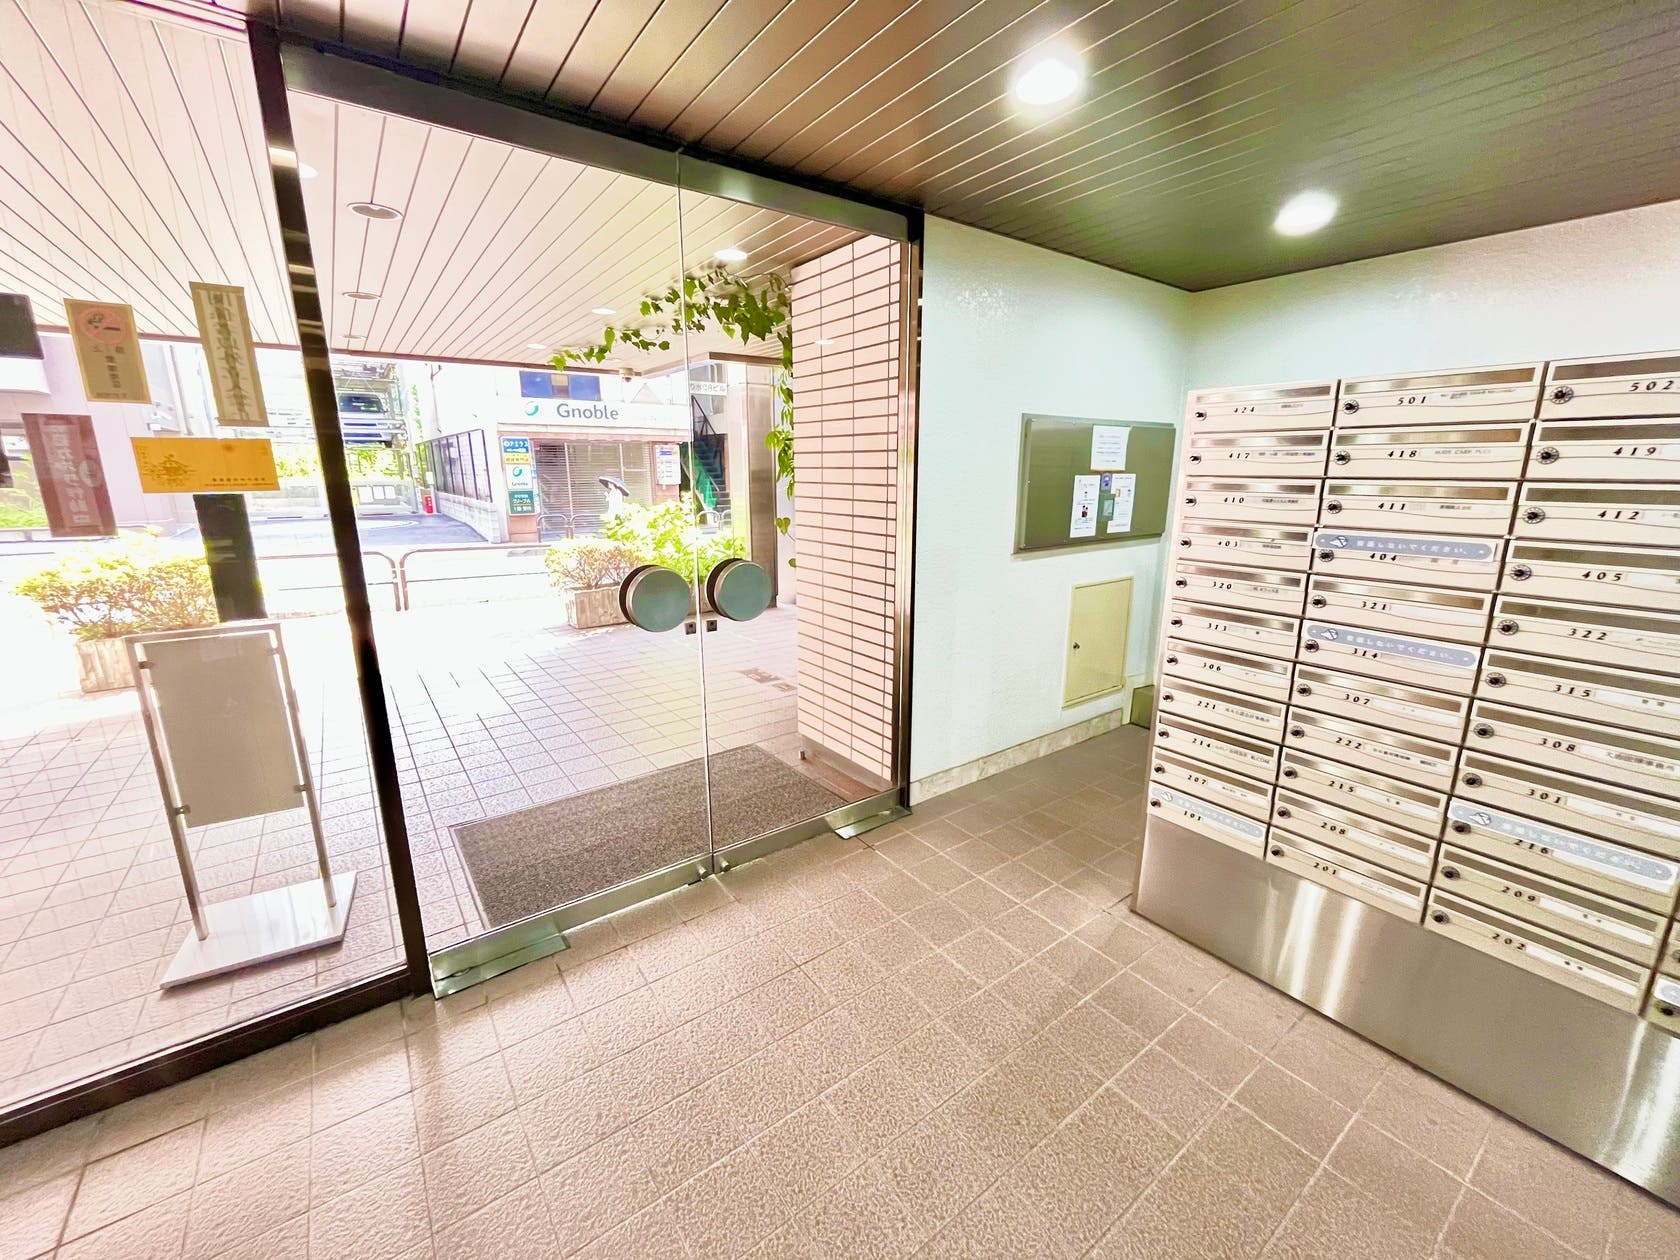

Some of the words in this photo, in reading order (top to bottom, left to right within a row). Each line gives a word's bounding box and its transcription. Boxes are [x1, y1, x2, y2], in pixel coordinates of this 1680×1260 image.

[1629, 380, 1674, 391] 502
[1398, 396, 1426, 405] 501
[556, 403, 619, 420] Gnoble
[1233, 406, 1256, 414] 424
[1228, 452, 1250, 460] 417
[1613, 447, 1656, 456] 419
[1223, 496, 1245, 504] 410
[1598, 511, 1639, 520] 412
[1217, 540, 1239, 548] 403
[1369, 552, 1398, 561] 404
[1581, 571, 1622, 581] 405
[1212, 581, 1233, 590] 320
[1362, 601, 1387, 611] 321
[1569, 628, 1607, 640] 322
[1352, 648, 1379, 659] 314
[1202, 662, 1221, 671] 306
[1554, 685, 1591, 697] 315
[1344, 693, 1370, 705] 307
[1197, 700, 1216, 710] 221
[1192, 738, 1211, 748] 214
[1336, 737, 1362, 749] 222
[1542, 738, 1576, 751] 308
[1187, 774, 1206, 785] 207
[1328, 781, 1354, 792] 215
[1529, 789, 1562, 804] 301
[1183, 810, 1202, 821] 101
[1321, 822, 1346, 835] 208
[1514, 838, 1549, 855] 216
[1314, 862, 1337, 875] 201
[1501, 886, 1536, 902] 209
[1492, 932, 1527, 950] 202
